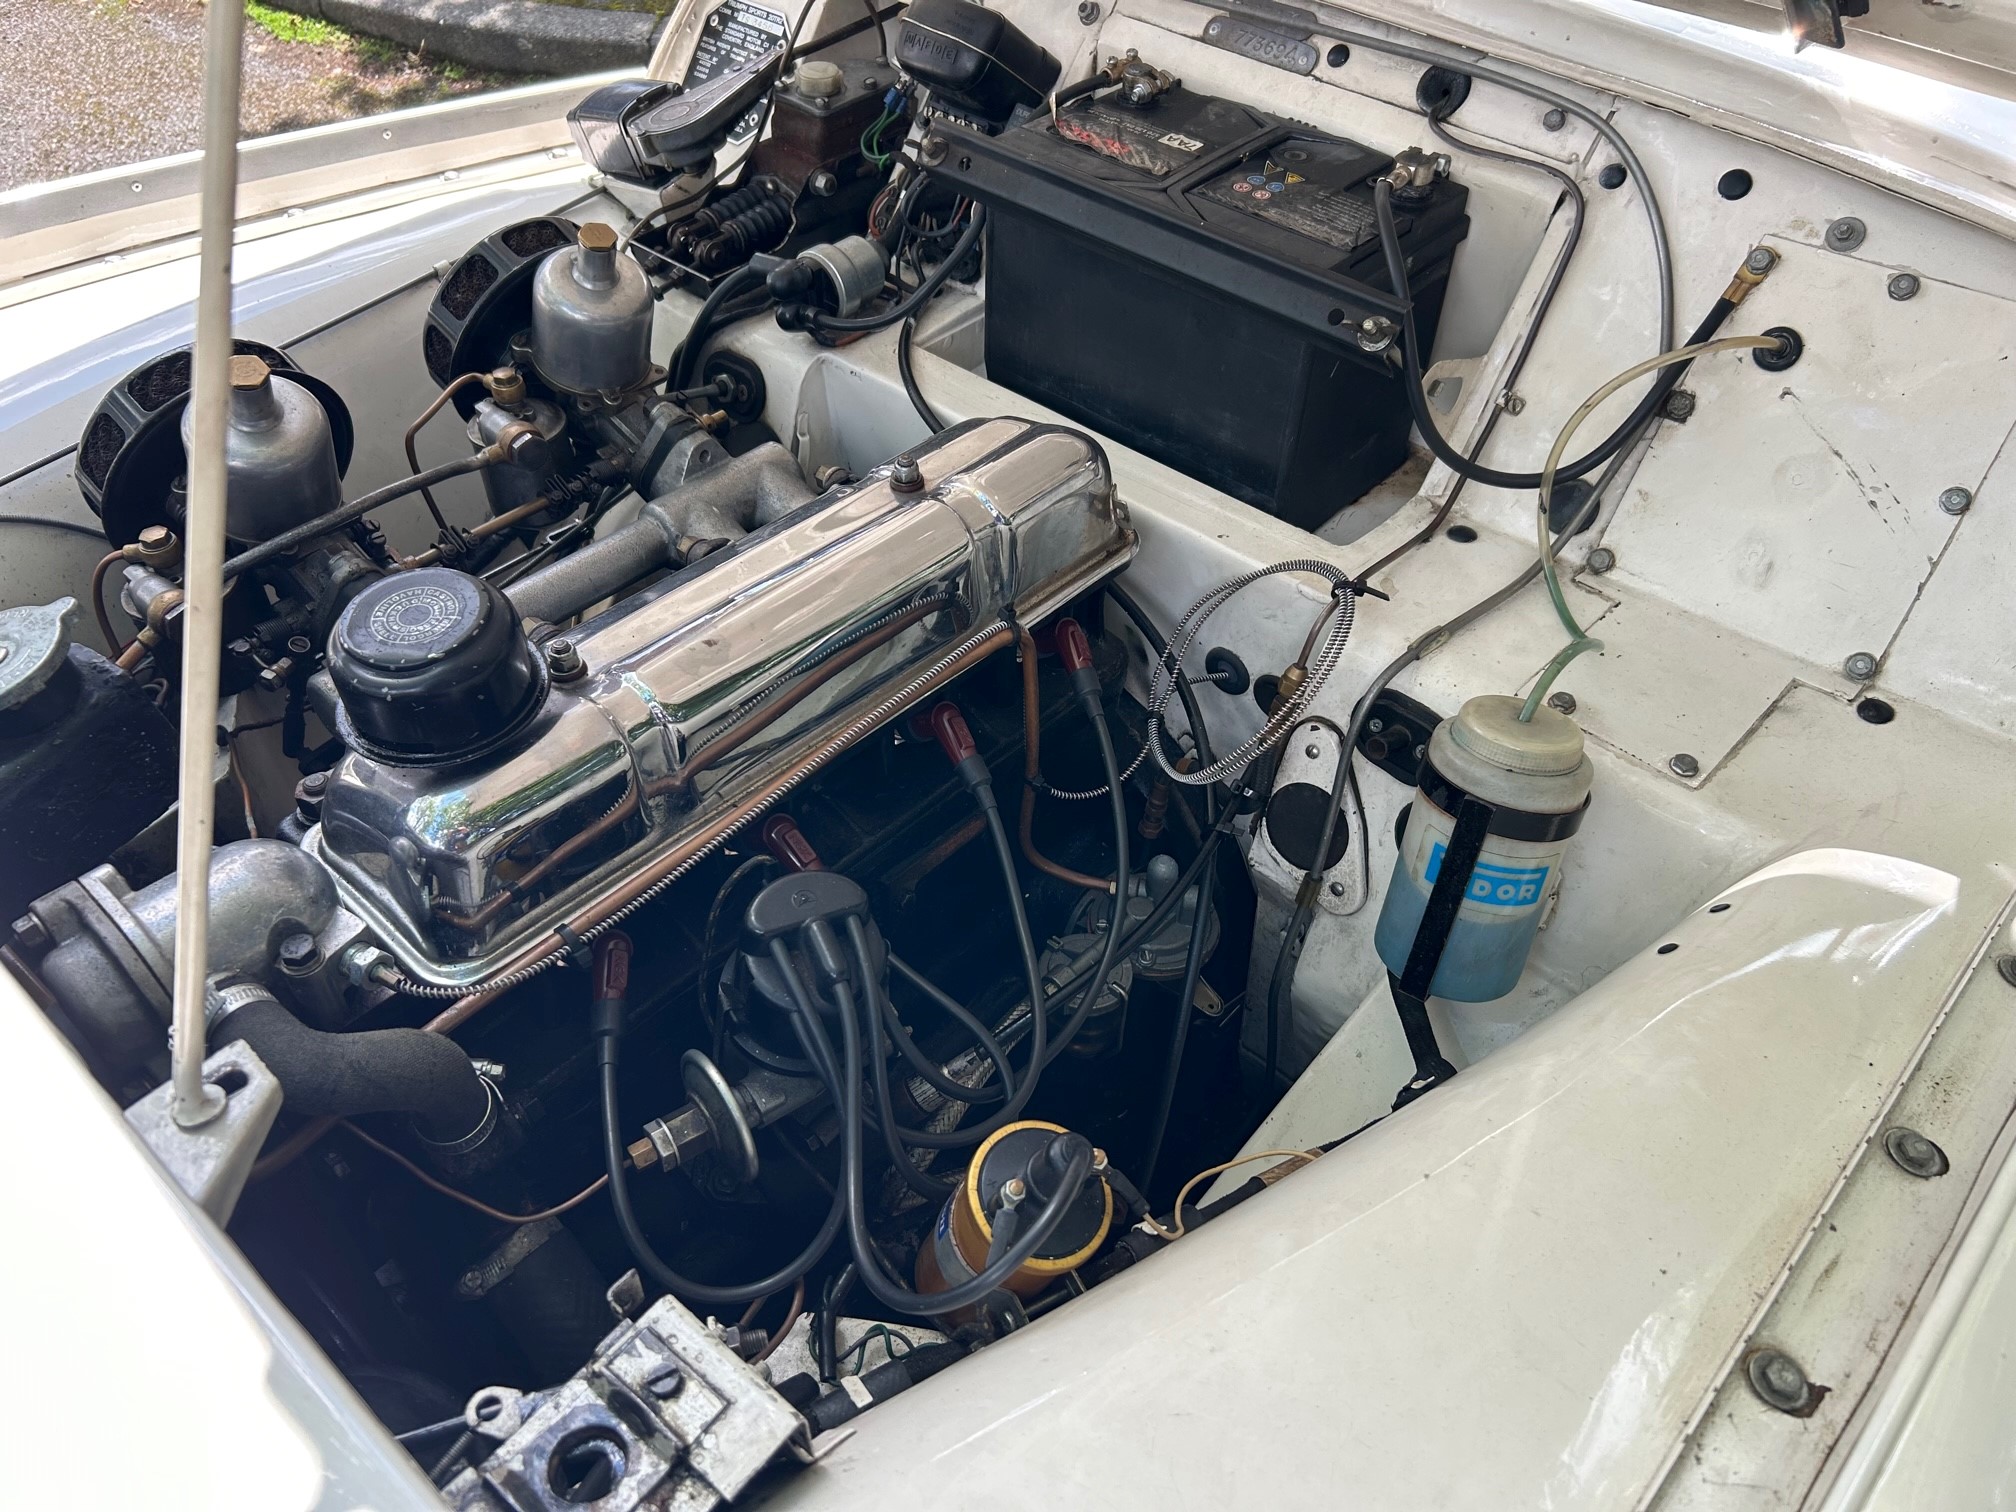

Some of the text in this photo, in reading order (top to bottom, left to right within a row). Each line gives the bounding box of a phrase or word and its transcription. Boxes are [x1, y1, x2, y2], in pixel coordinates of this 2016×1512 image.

[748, 7, 767, 19] SPORTS
[724, 27, 745, 40] STANDARD
[745, 35, 761, 46] MOTOR
[727, 21, 768, 41] MANUFACTURED BY
[375, 589, 422, 617] HAVOLINE
[427, 589, 456, 615] CASTROL
[387, 598, 419, 632] DUCKHAMS
[373, 621, 397, 640] SHELL
